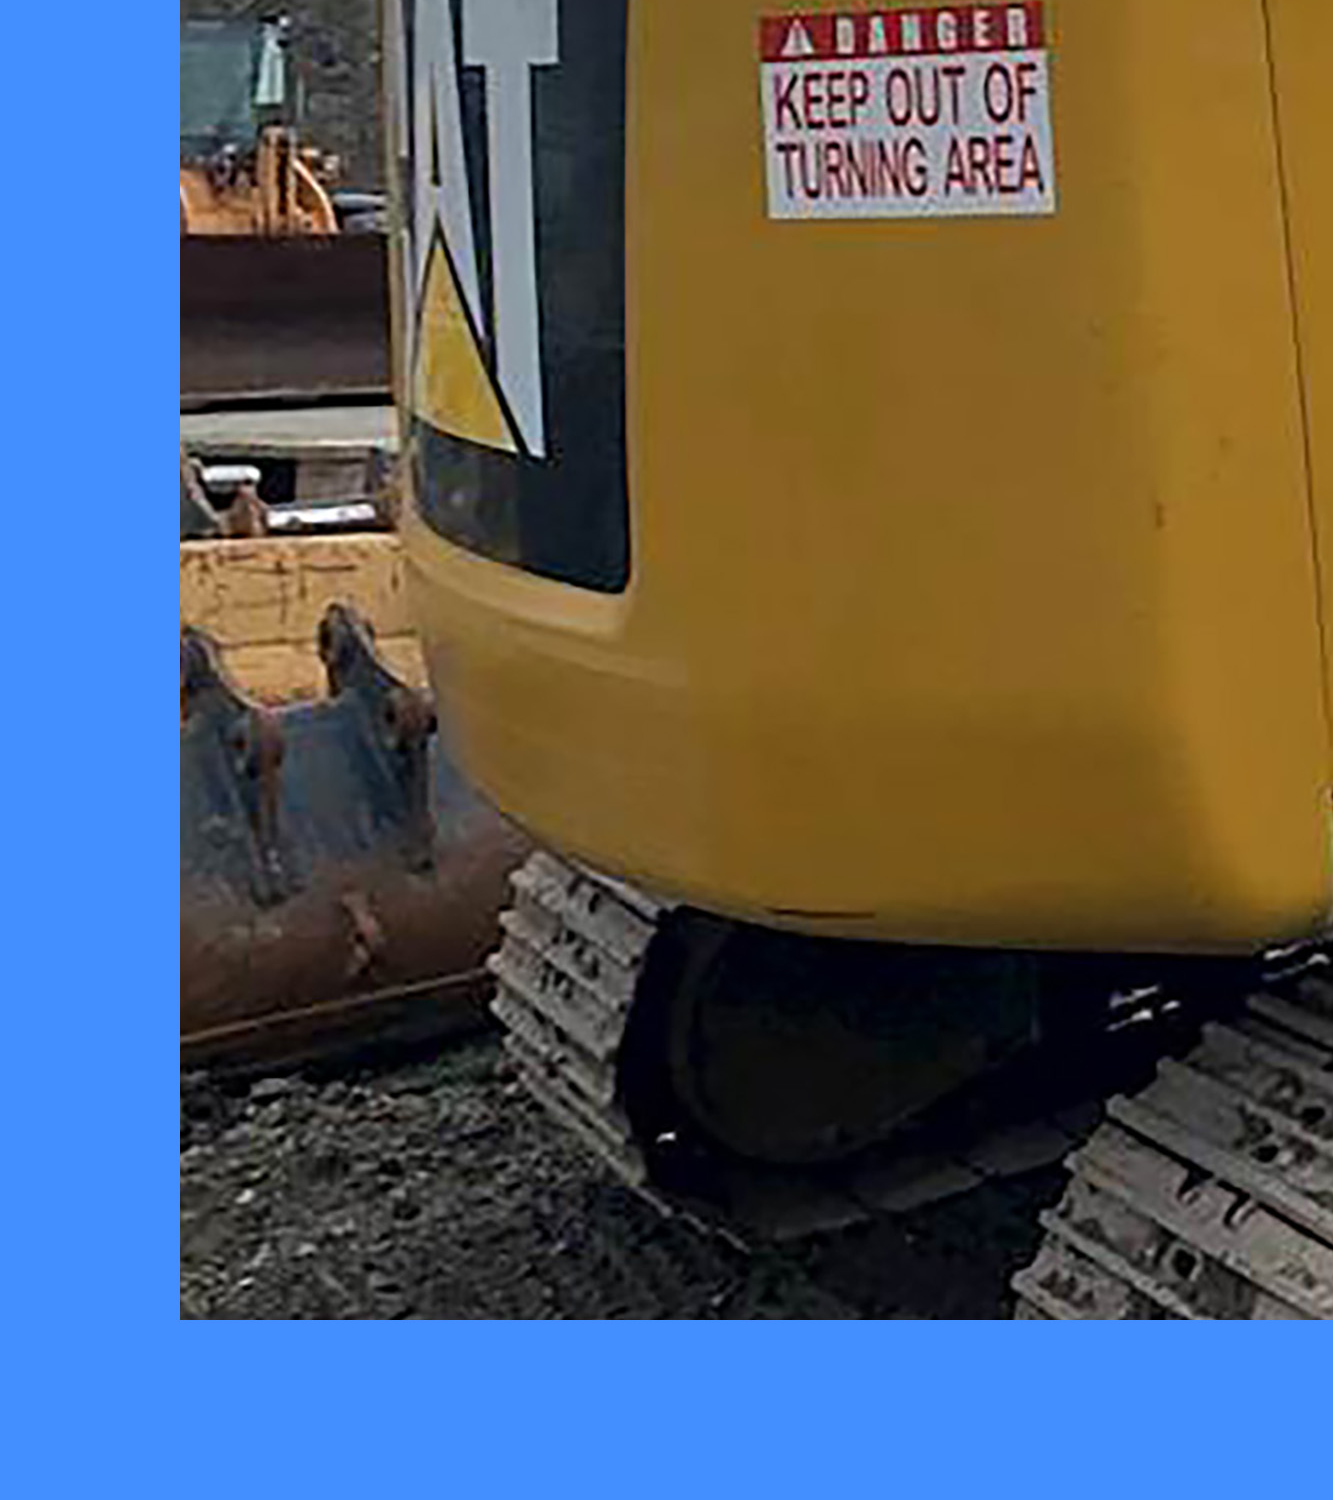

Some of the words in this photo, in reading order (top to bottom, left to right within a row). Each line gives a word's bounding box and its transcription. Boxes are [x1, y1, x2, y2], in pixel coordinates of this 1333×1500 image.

[835, 8, 1027, 55] DANGER
[774, 70, 869, 130] KEEP
[886, 65, 966, 126] OUT
[984, 62, 1037, 124] OF
[775, 136, 928, 199] TURNING
[944, 133, 1045, 197] AREA
